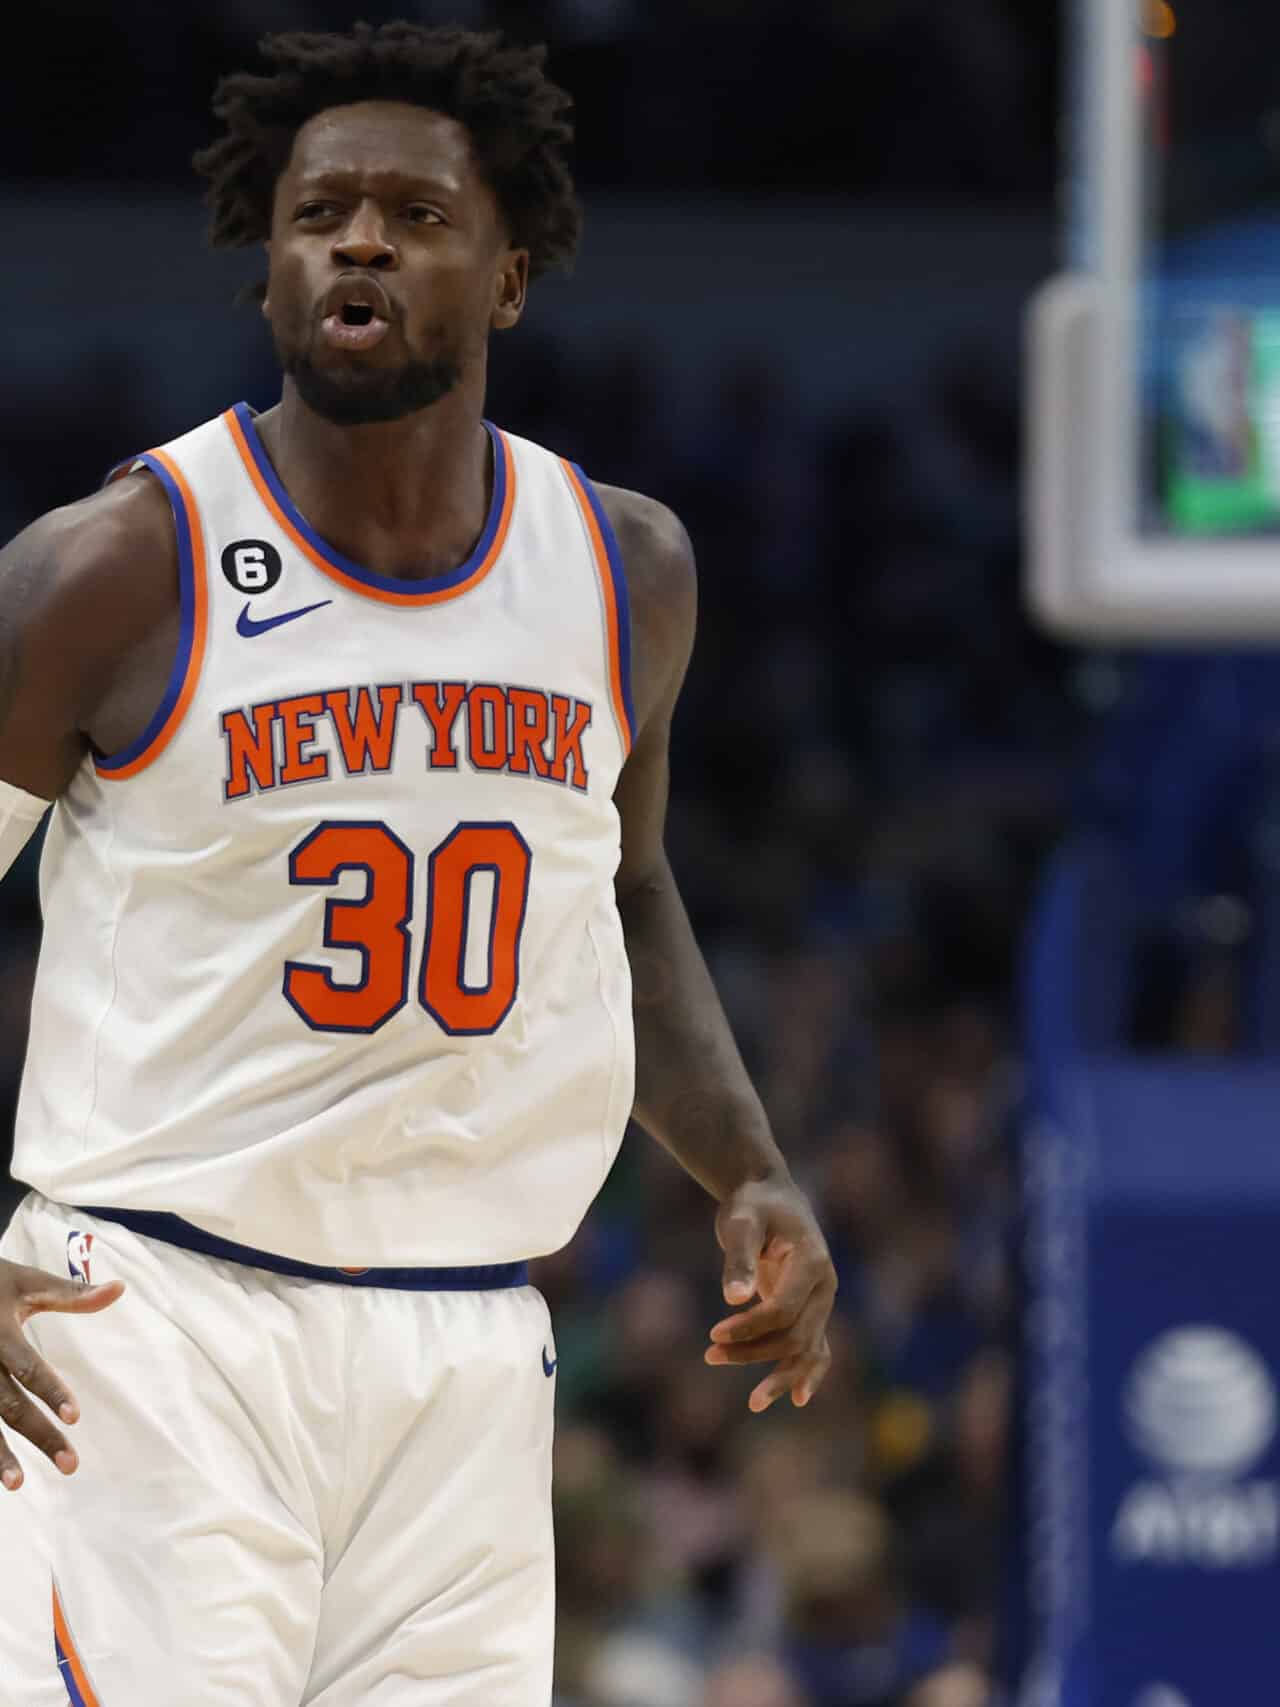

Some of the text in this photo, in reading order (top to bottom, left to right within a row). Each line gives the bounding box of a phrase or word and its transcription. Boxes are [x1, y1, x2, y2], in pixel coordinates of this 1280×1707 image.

[234, 547, 269, 588] 6
[221, 681, 592, 802] NEW YORK
[282, 820, 532, 1036] 30
